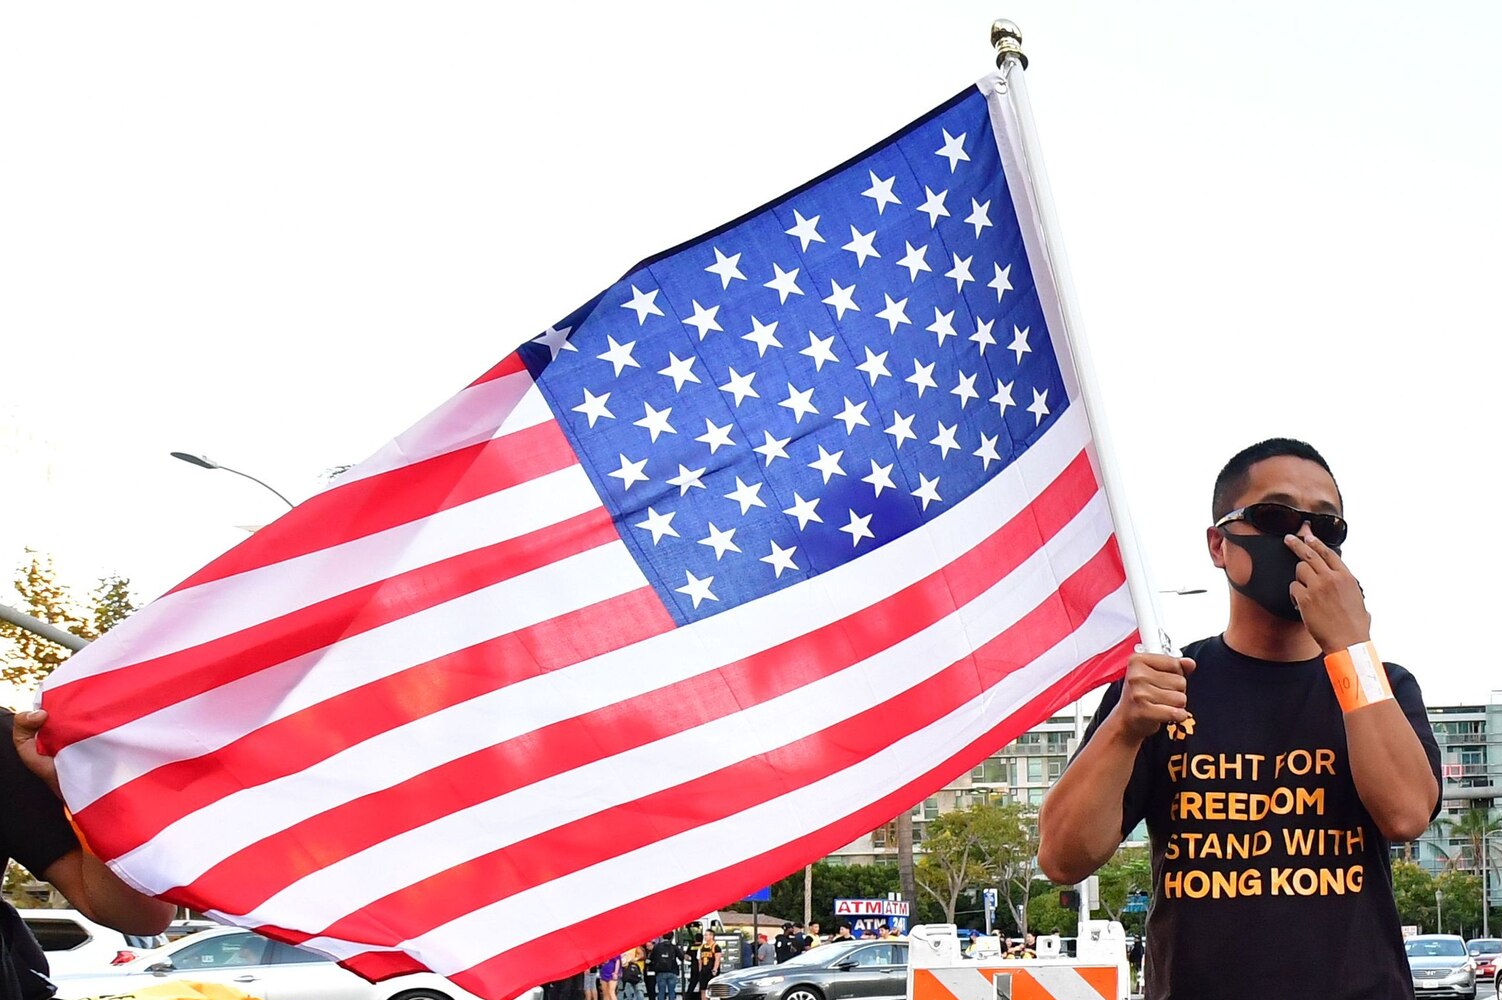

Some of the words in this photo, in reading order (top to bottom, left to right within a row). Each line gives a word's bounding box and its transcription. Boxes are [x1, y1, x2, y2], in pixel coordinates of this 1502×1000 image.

[1167, 752, 1266, 782] FIGHT
[1274, 748, 1336, 779] FOR
[1171, 786, 1325, 821] FREEDOM
[1165, 830, 1273, 860] STAND
[1282, 826, 1365, 856] WITH
[1164, 869, 1263, 899] HONG
[1270, 864, 1364, 896] KONG
[837, 901, 881, 913] ATM
[885, 902, 907, 915] ATM
[854, 918, 887, 931] ATM
